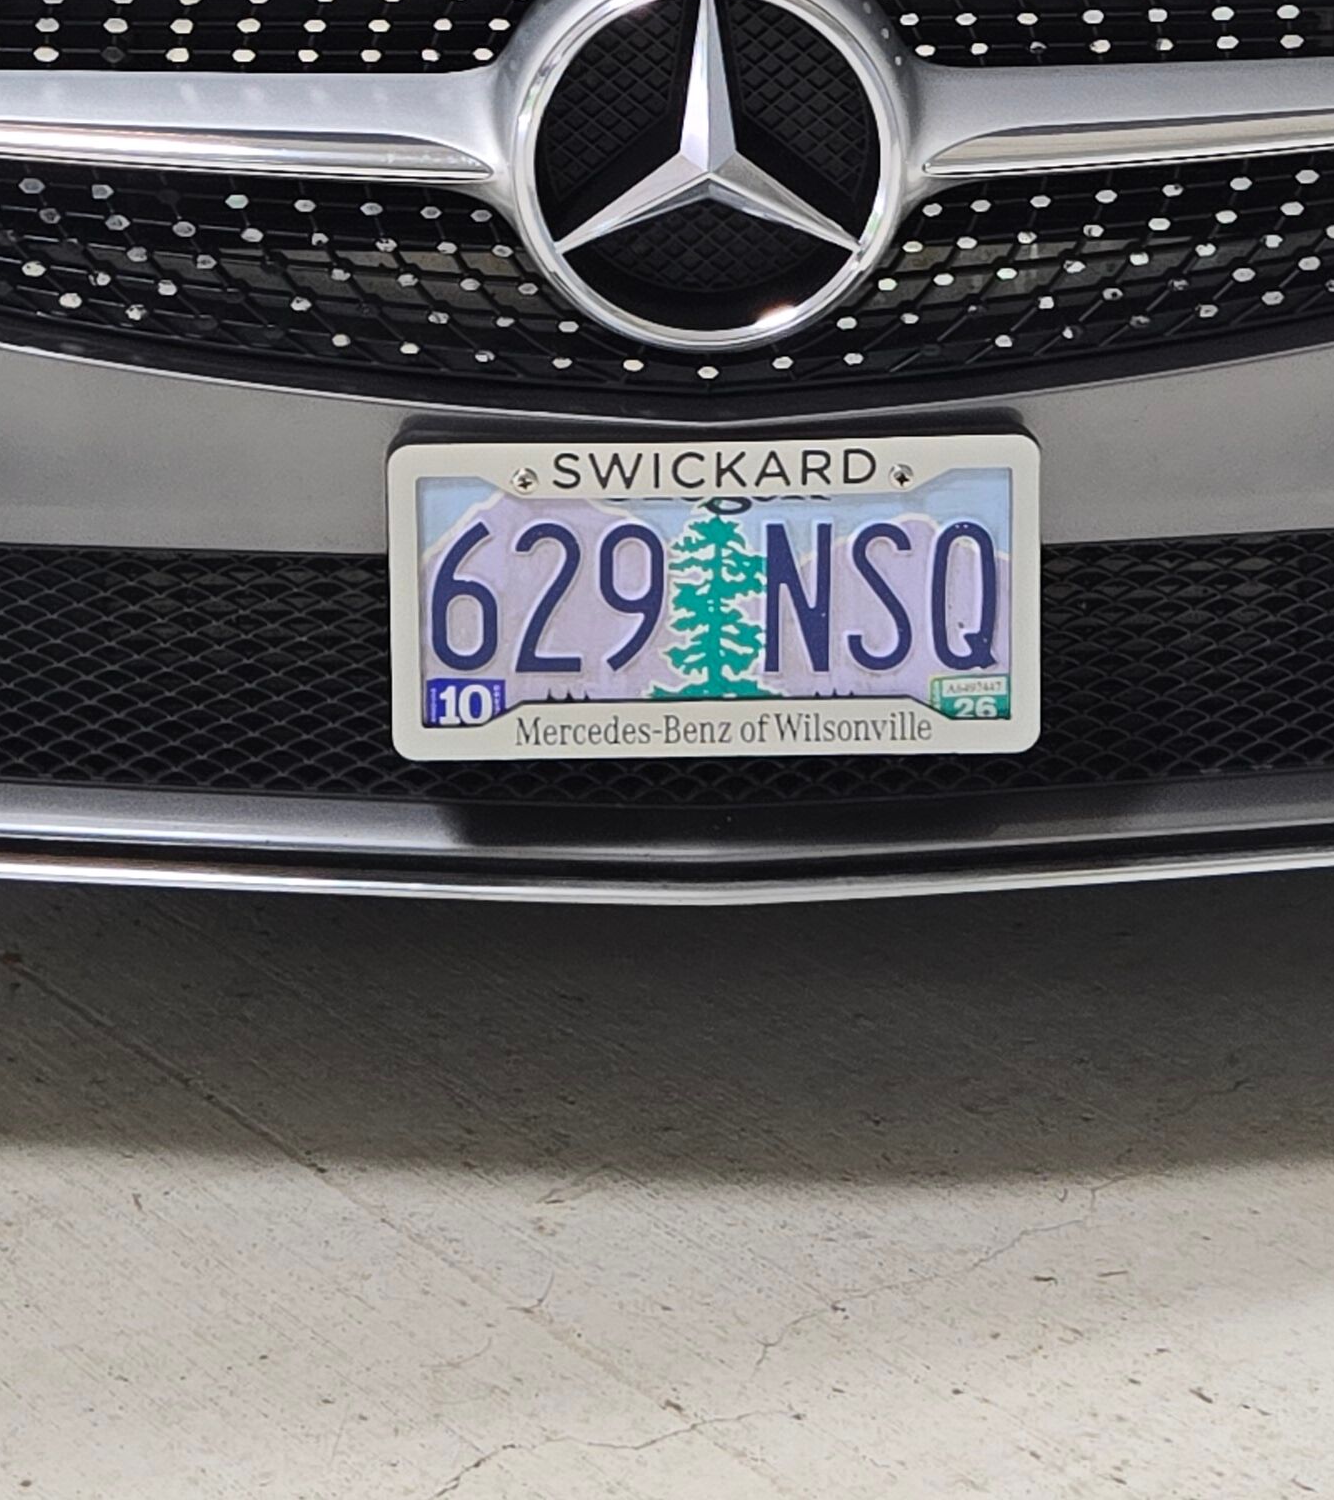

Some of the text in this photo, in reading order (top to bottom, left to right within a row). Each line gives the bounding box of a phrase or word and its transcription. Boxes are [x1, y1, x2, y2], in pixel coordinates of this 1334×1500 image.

[552, 448, 877, 490] SWICKARD
[431, 520, 997, 673] 629 NSQ
[439, 684, 493, 724] 10
[953, 696, 998, 718] 26
[516, 711, 932, 746] Mercedes-Benz of Wilsonville
